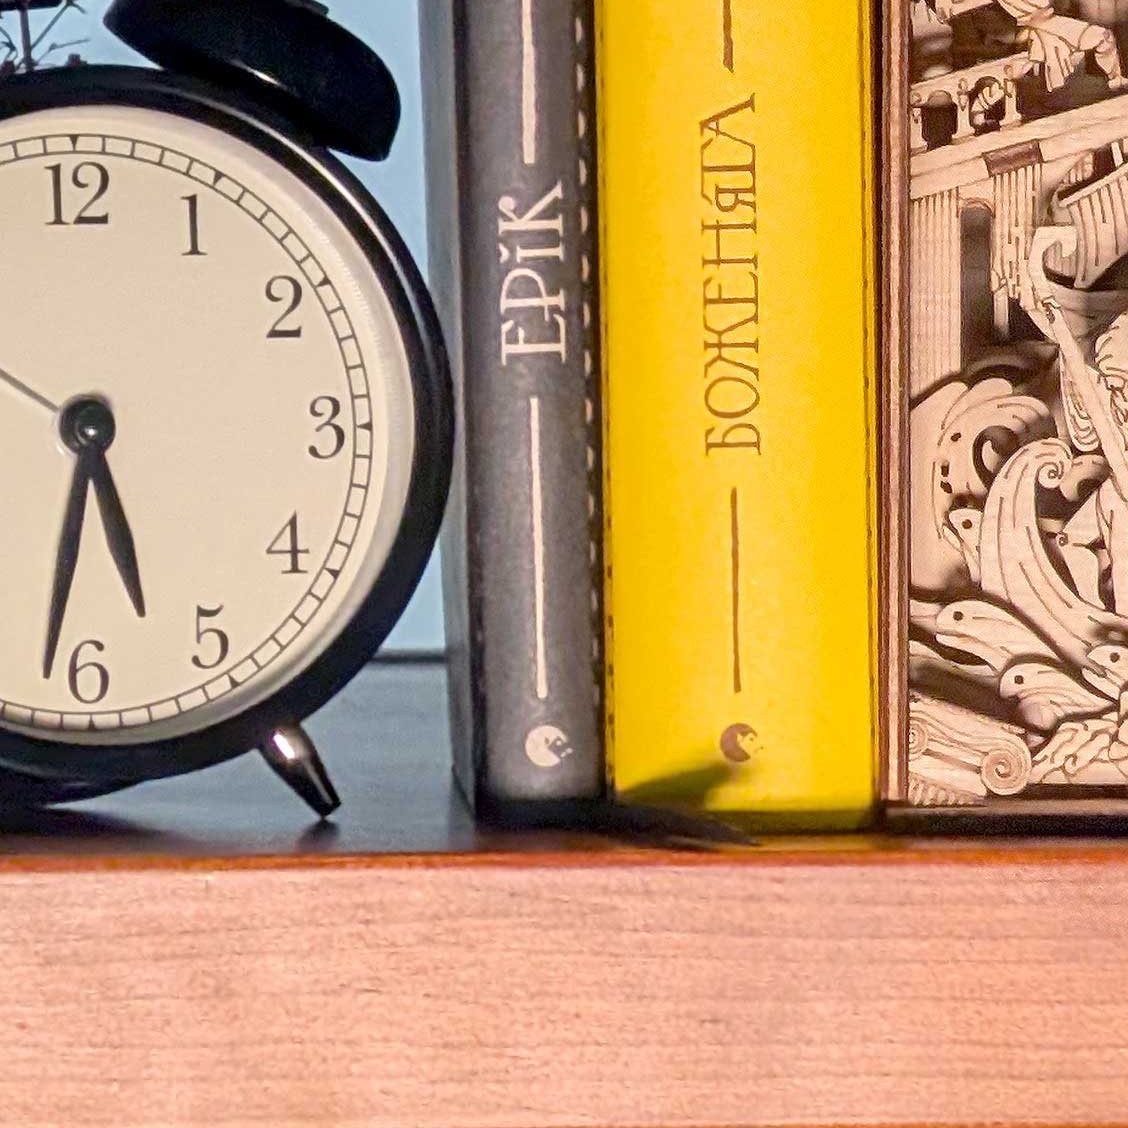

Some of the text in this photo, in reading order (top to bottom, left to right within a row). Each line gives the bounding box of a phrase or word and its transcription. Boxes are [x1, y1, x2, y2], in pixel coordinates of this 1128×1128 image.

[45, 161, 110, 226] 12
[181, 194, 208, 256] 1
[266, 275, 303, 339] 2
[308, 395, 346, 460] 3
[266, 510, 310, 574] 4
[191, 604, 230, 670] 5
[67, 639, 110, 704] 6
